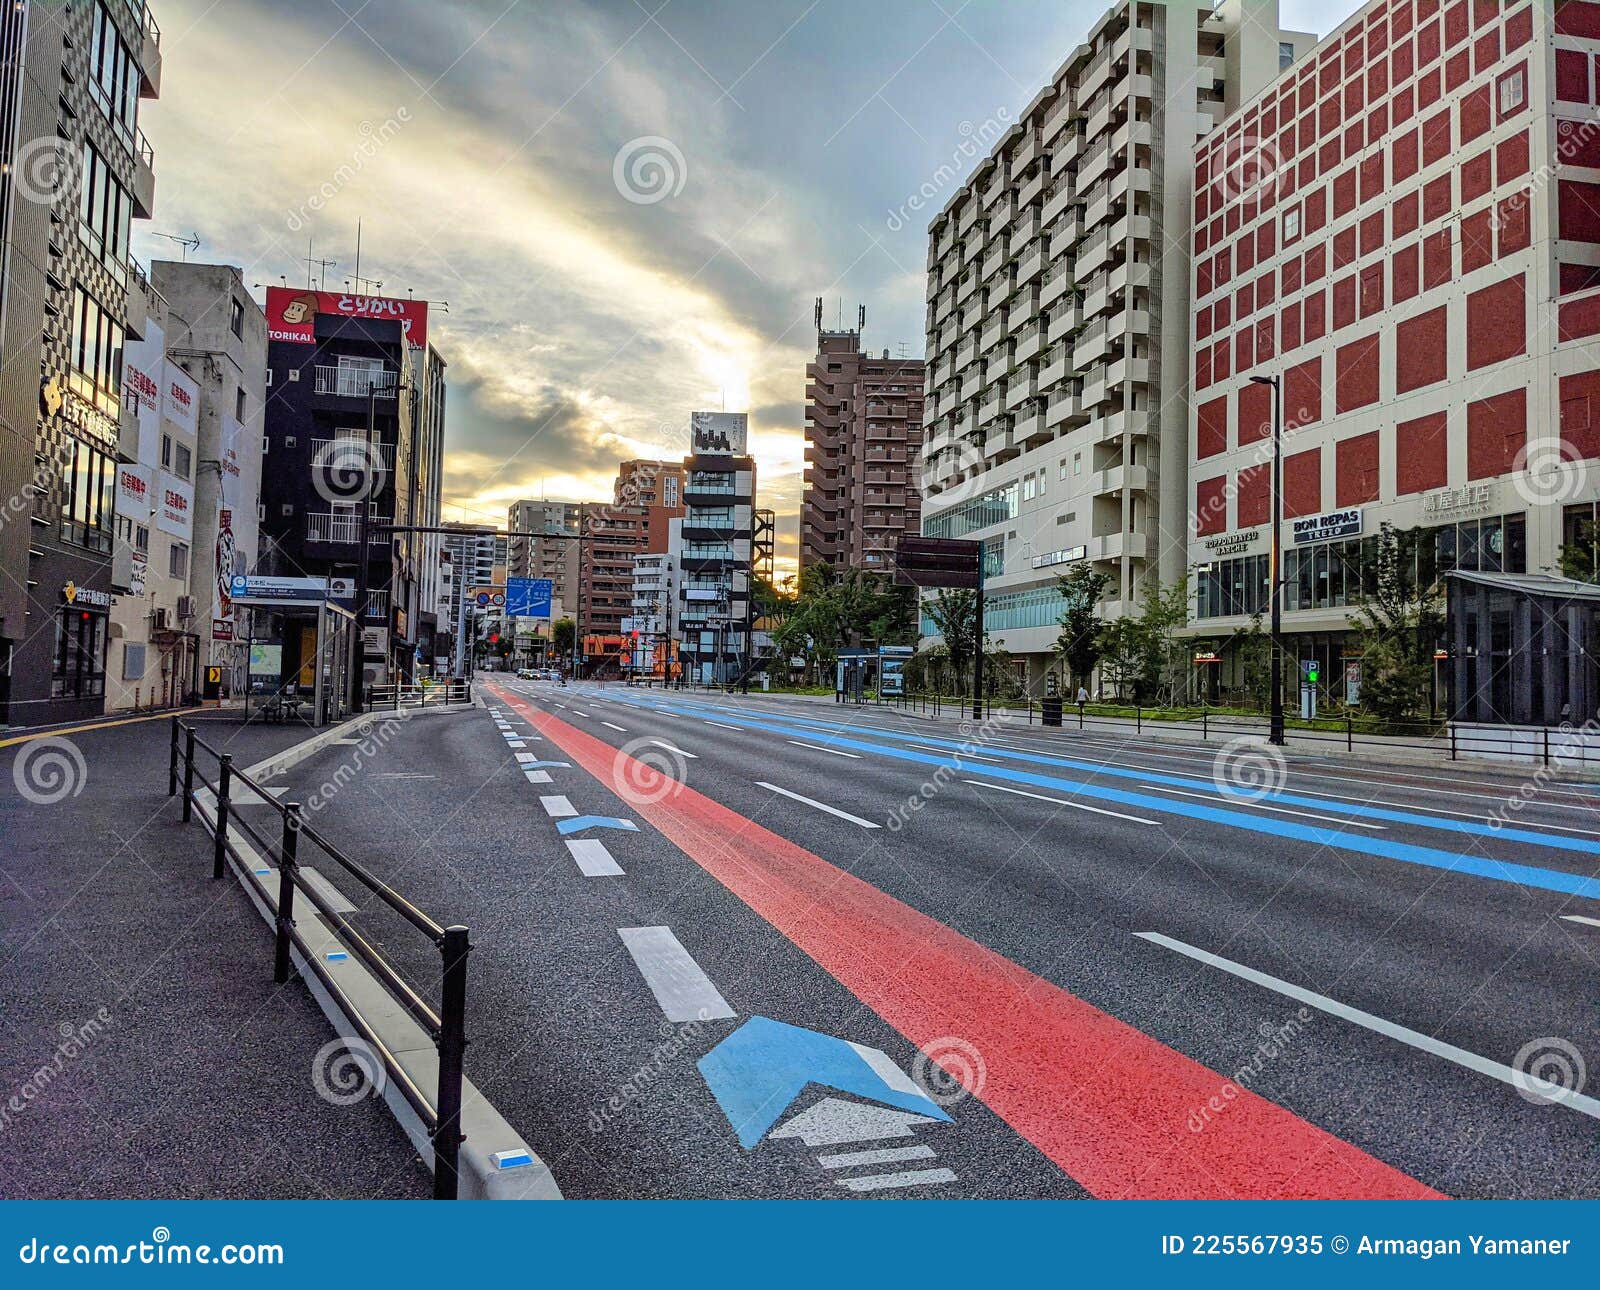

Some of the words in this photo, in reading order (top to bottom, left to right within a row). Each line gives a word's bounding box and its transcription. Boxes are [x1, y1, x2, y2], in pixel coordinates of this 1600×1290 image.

[338, 295, 405, 315] とりかい
[269, 330, 310, 341] TORIKAI
[1294, 518, 1317, 532] BON
[1320, 510, 1359, 527] REPAS
[1309, 663, 1317, 674] P
